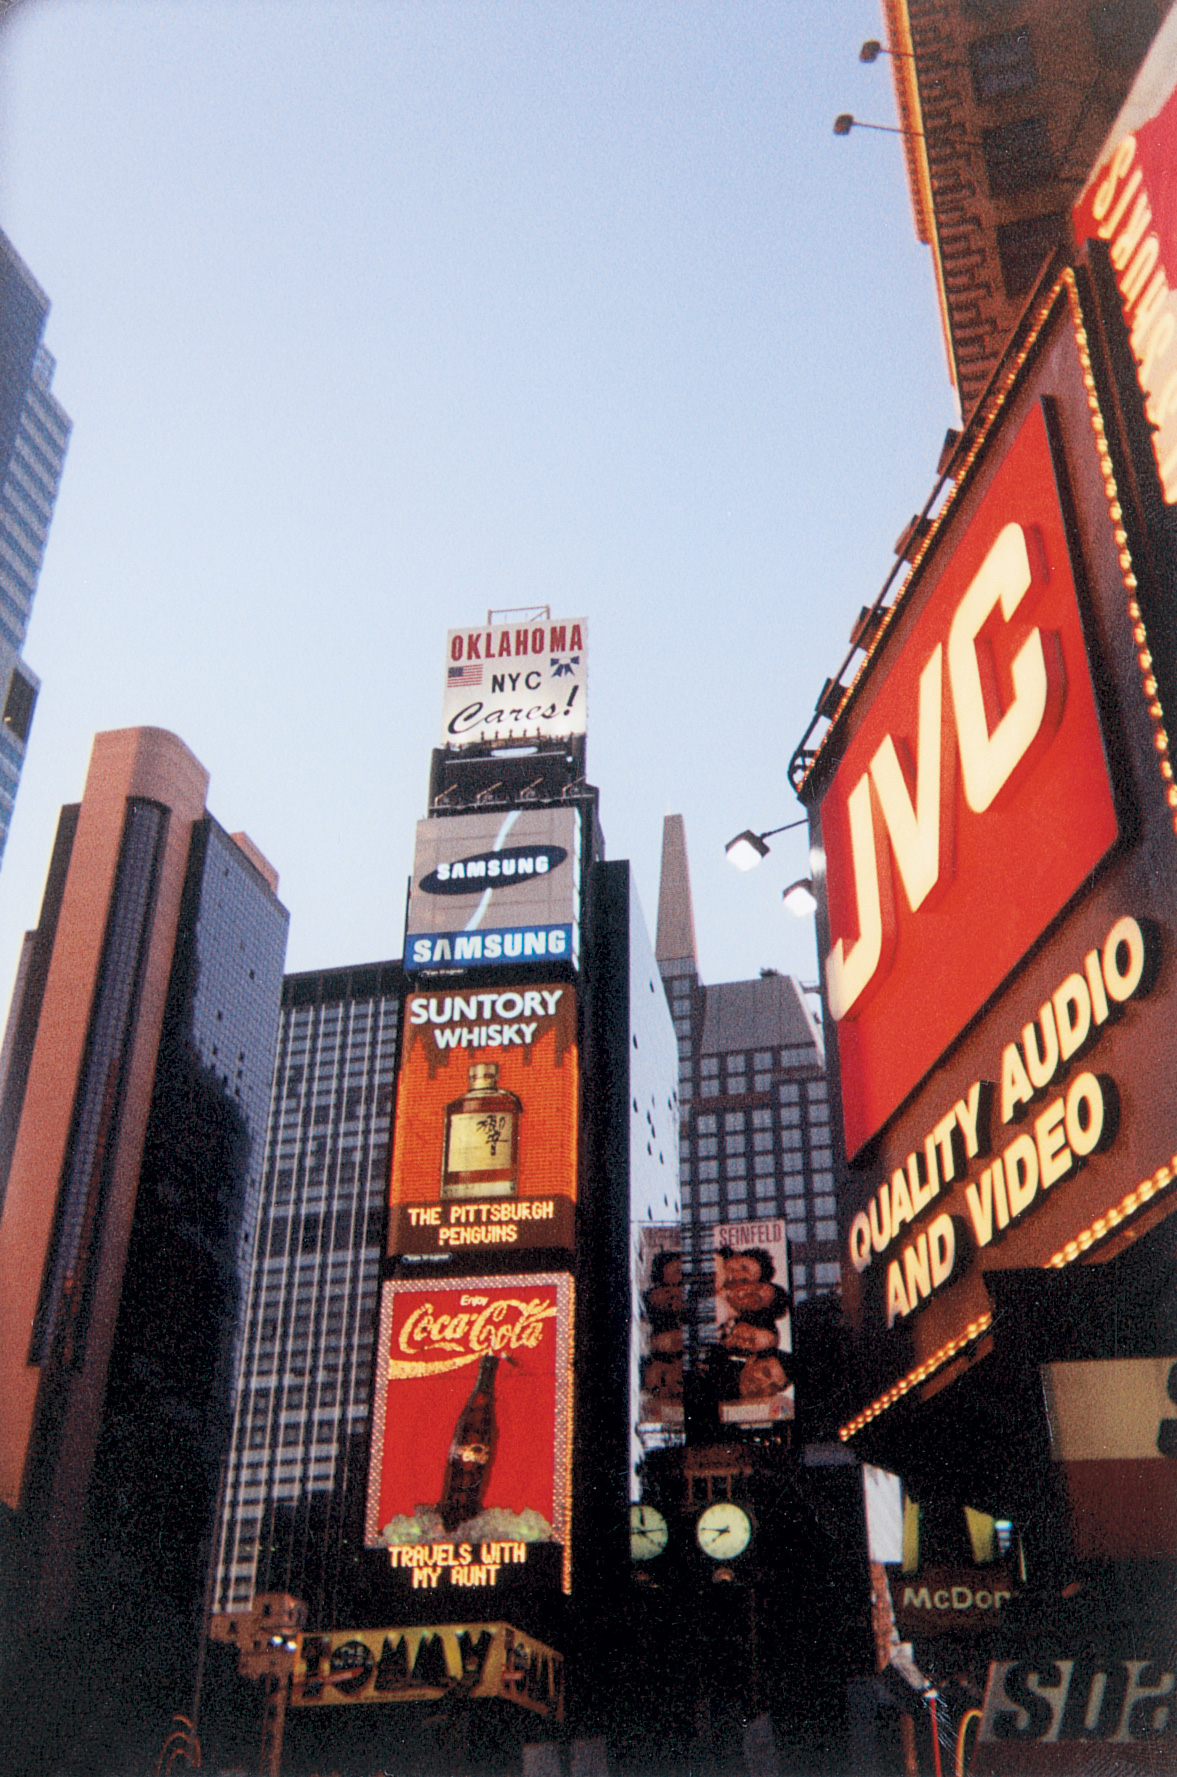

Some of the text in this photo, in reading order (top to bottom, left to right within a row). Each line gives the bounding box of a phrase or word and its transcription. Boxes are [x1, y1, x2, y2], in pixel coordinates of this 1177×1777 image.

[450, 624, 583, 662] OKLAHOMA
[491, 671, 542, 693] NYC
[447, 685, 579, 735] Cares!
[826, 522, 1047, 1021] JVC
[436, 855, 549, 881] SAMSUNG
[413, 930, 567, 963] SAMSUNG
[410, 989, 563, 1024] SUNTORY
[434, 1022, 538, 1049] WHISKY
[849, 915, 1145, 1273] QUALITY AUDIO
[408, 1201, 554, 1226] THE PITTSBURGH
[886, 1071, 1104, 1329] AND VIDEO
[438, 1225, 518, 1246] PENGUINS
[719, 1223, 781, 1248] SEINFELD
[460, 1294, 490, 1307] Enjoy
[398, 1298, 552, 1354] Coca-Cola
[388, 1541, 527, 1568] TRAVELS WITH
[412, 1564, 501, 1588] MY AUNT
